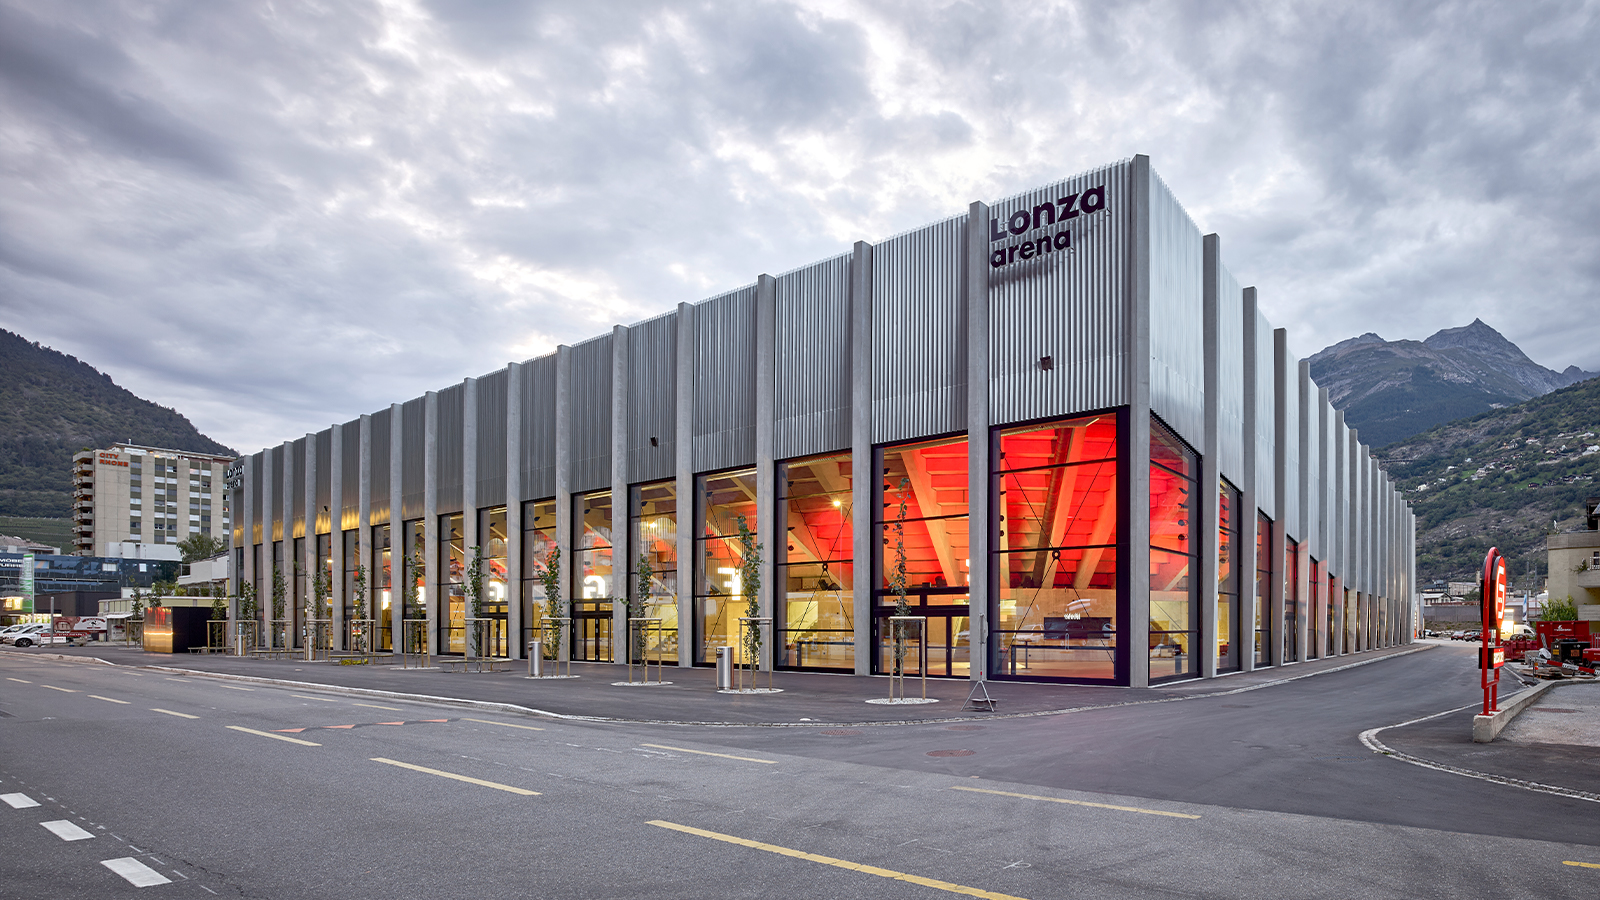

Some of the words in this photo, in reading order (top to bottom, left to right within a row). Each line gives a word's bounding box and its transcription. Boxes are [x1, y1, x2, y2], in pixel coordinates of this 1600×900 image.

[990, 184, 1106, 243] Lonza
[990, 229, 1071, 268] arena
[99, 452, 119, 460] CITY
[99, 458, 129, 468] RHONE
